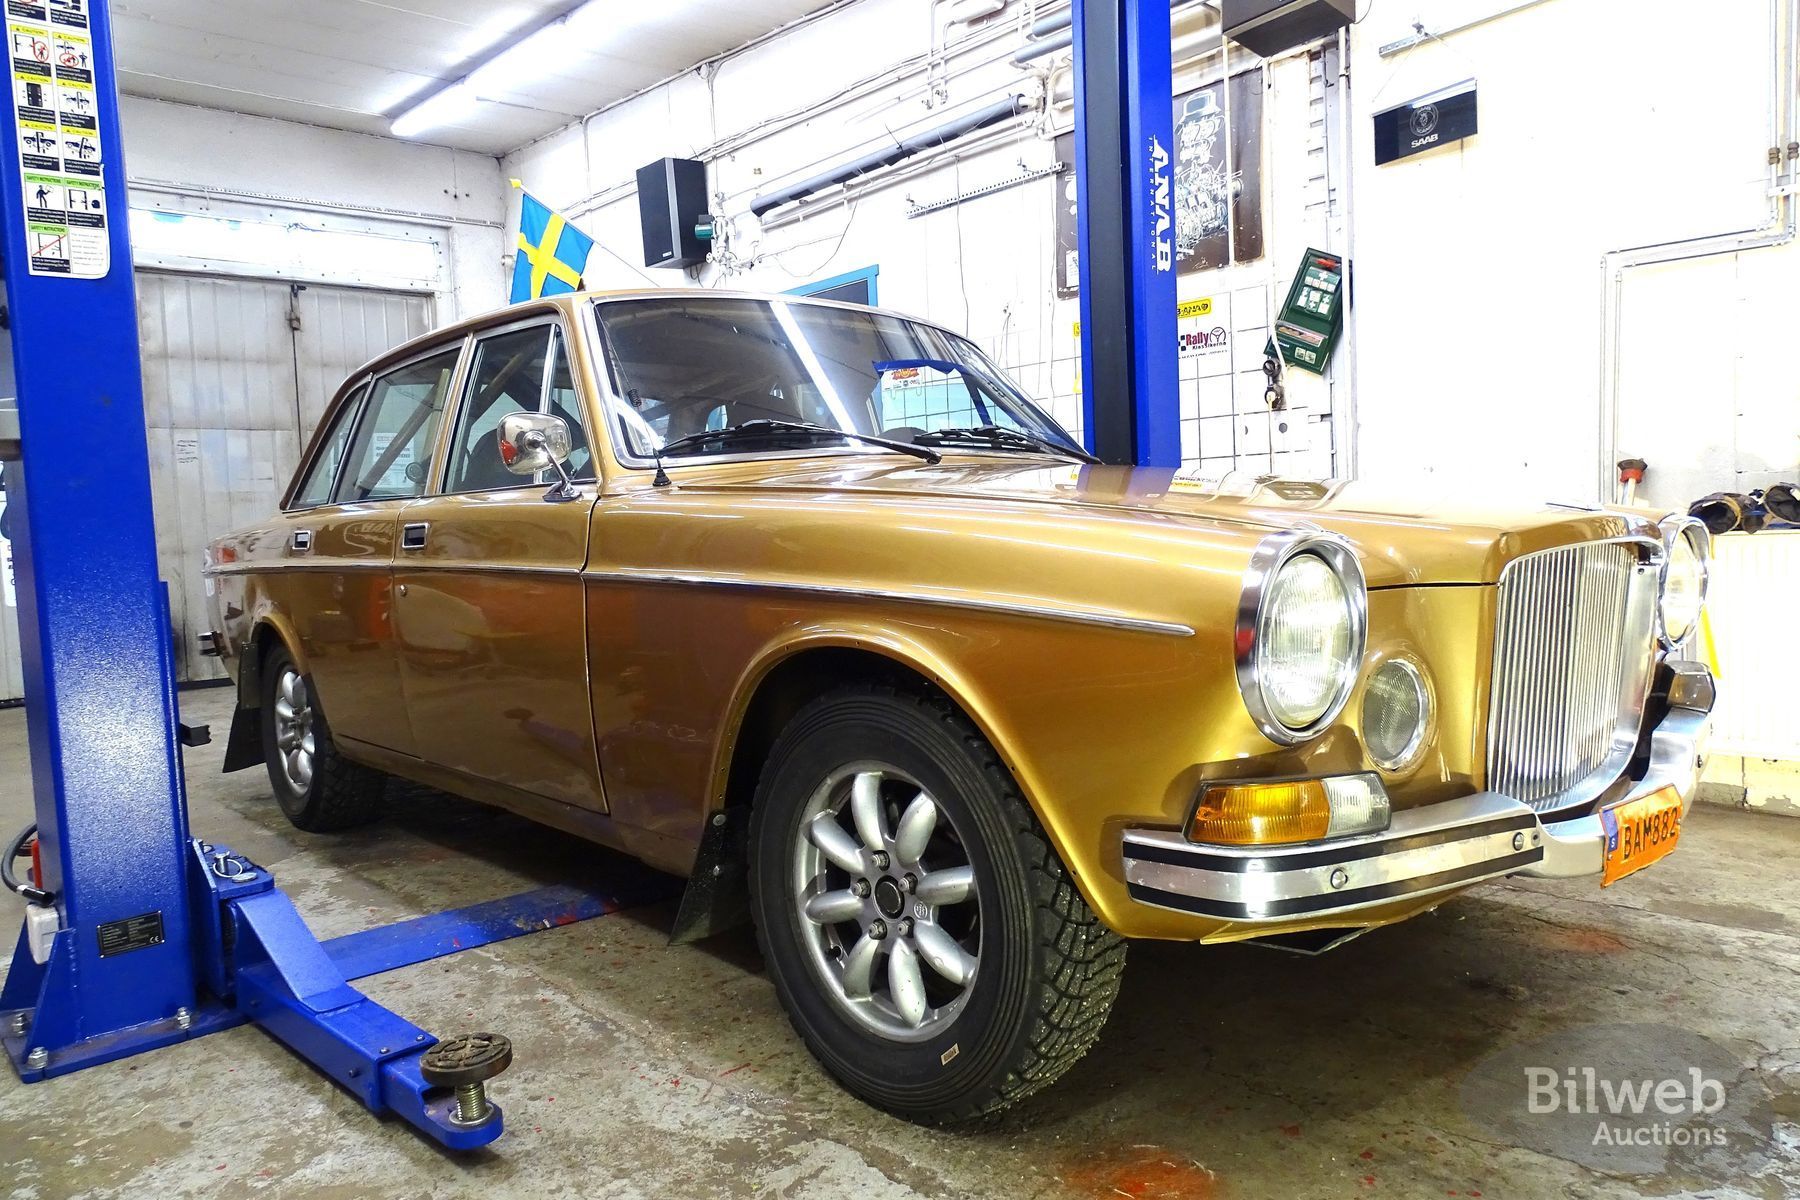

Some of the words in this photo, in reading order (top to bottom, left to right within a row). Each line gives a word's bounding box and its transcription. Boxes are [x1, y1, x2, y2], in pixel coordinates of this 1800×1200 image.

[1411, 133, 1439, 148] SAAB
[1152, 134, 1171, 275] ANAB
[1186, 332, 1209, 347] Rally
[1192, 342, 1227, 350] Klassikerna
[1610, 837, 1616, 848] S
